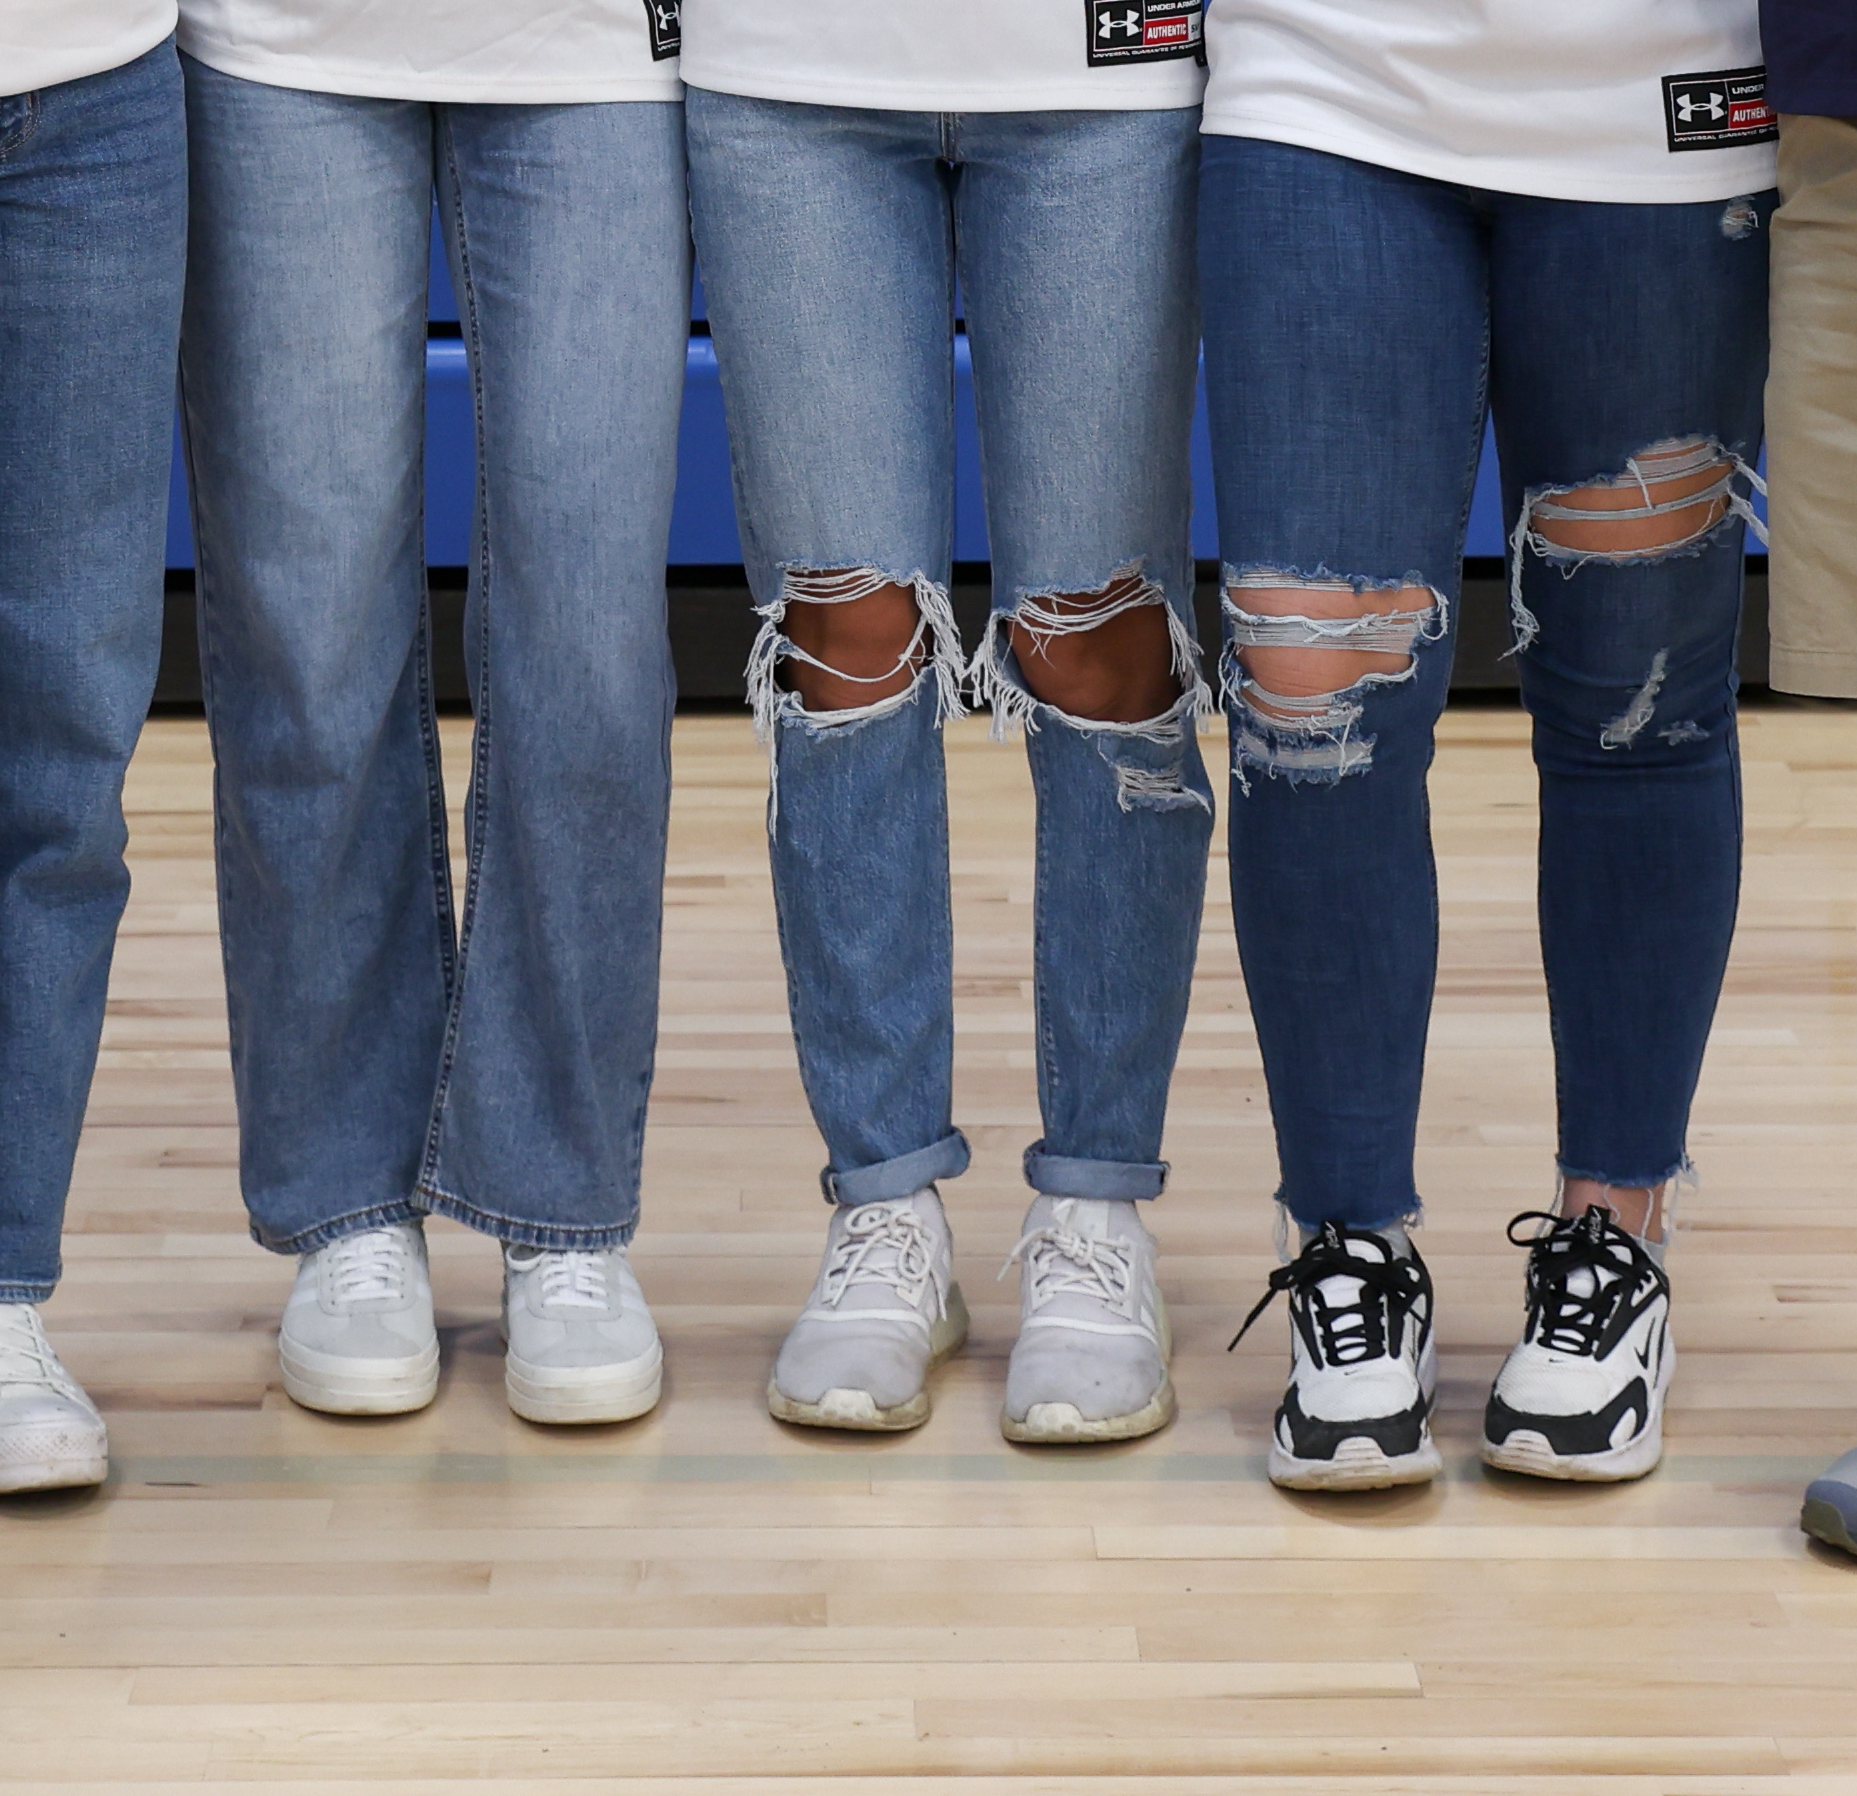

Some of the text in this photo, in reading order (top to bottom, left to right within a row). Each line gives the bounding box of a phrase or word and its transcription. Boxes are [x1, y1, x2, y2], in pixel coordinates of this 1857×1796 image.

[1147, 2, 1176, 12] UNDER
[1147, 23, 1186, 40] AUTHENTIC
[1732, 106, 1773, 122] AUTHENT
